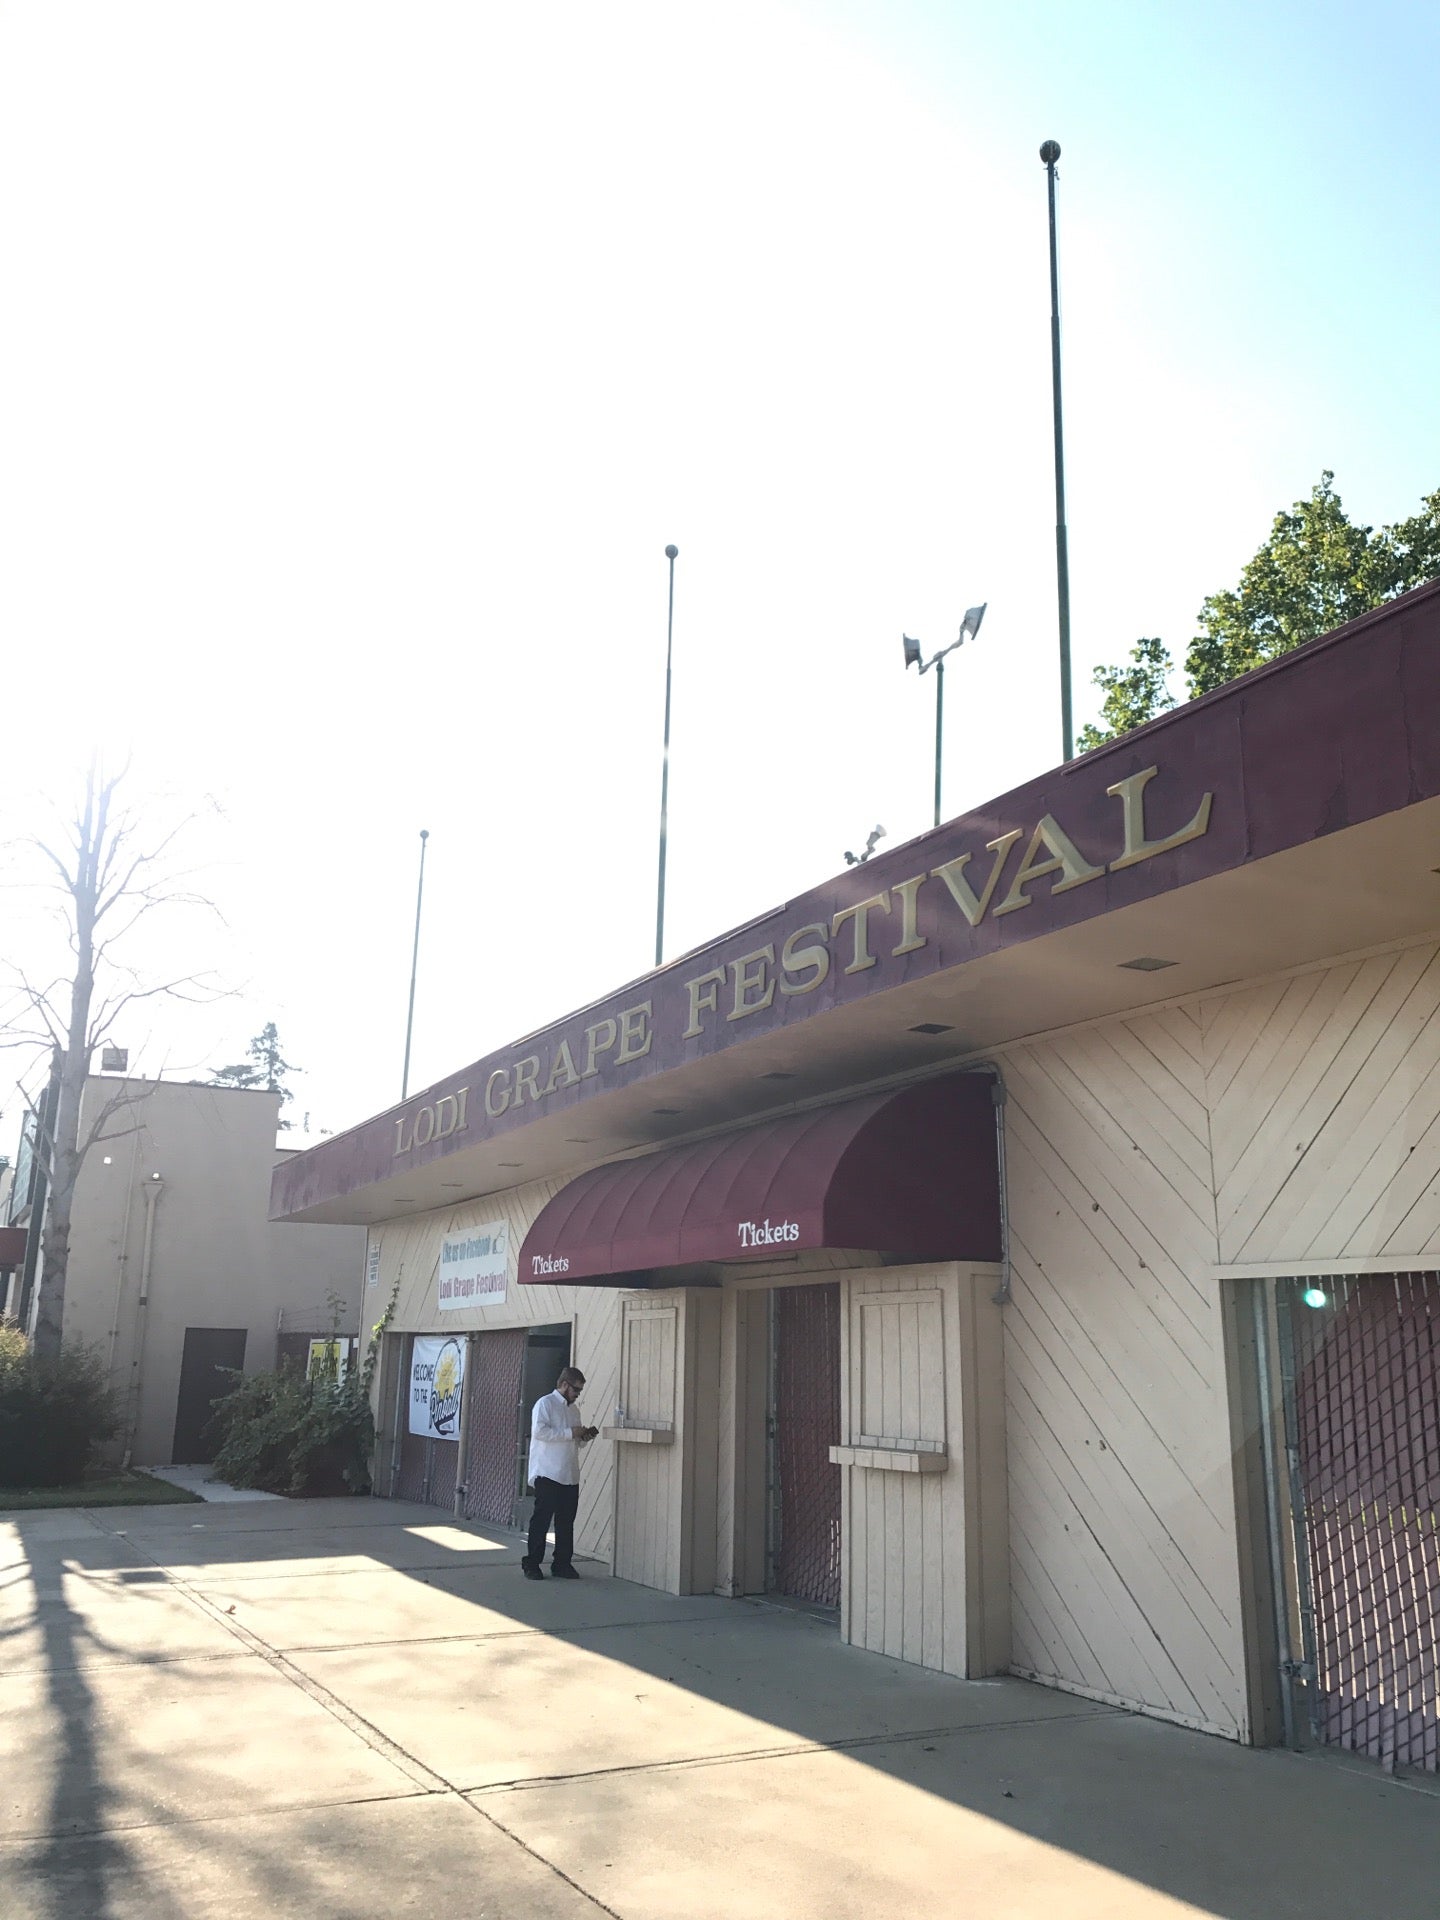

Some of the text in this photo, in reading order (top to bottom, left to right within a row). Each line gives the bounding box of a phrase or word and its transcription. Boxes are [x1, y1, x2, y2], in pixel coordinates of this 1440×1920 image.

[393, 765, 1214, 1158] LODI GRAPE FESTIVAL
[738, 1218, 800, 1248] Tickets
[532, 1254, 569, 1275] Tickets
[440, 1269, 506, 1299] Lodi Grape Festival
[413, 1364, 434, 1382] WELCOME
[414, 1388, 420, 1403] TO
